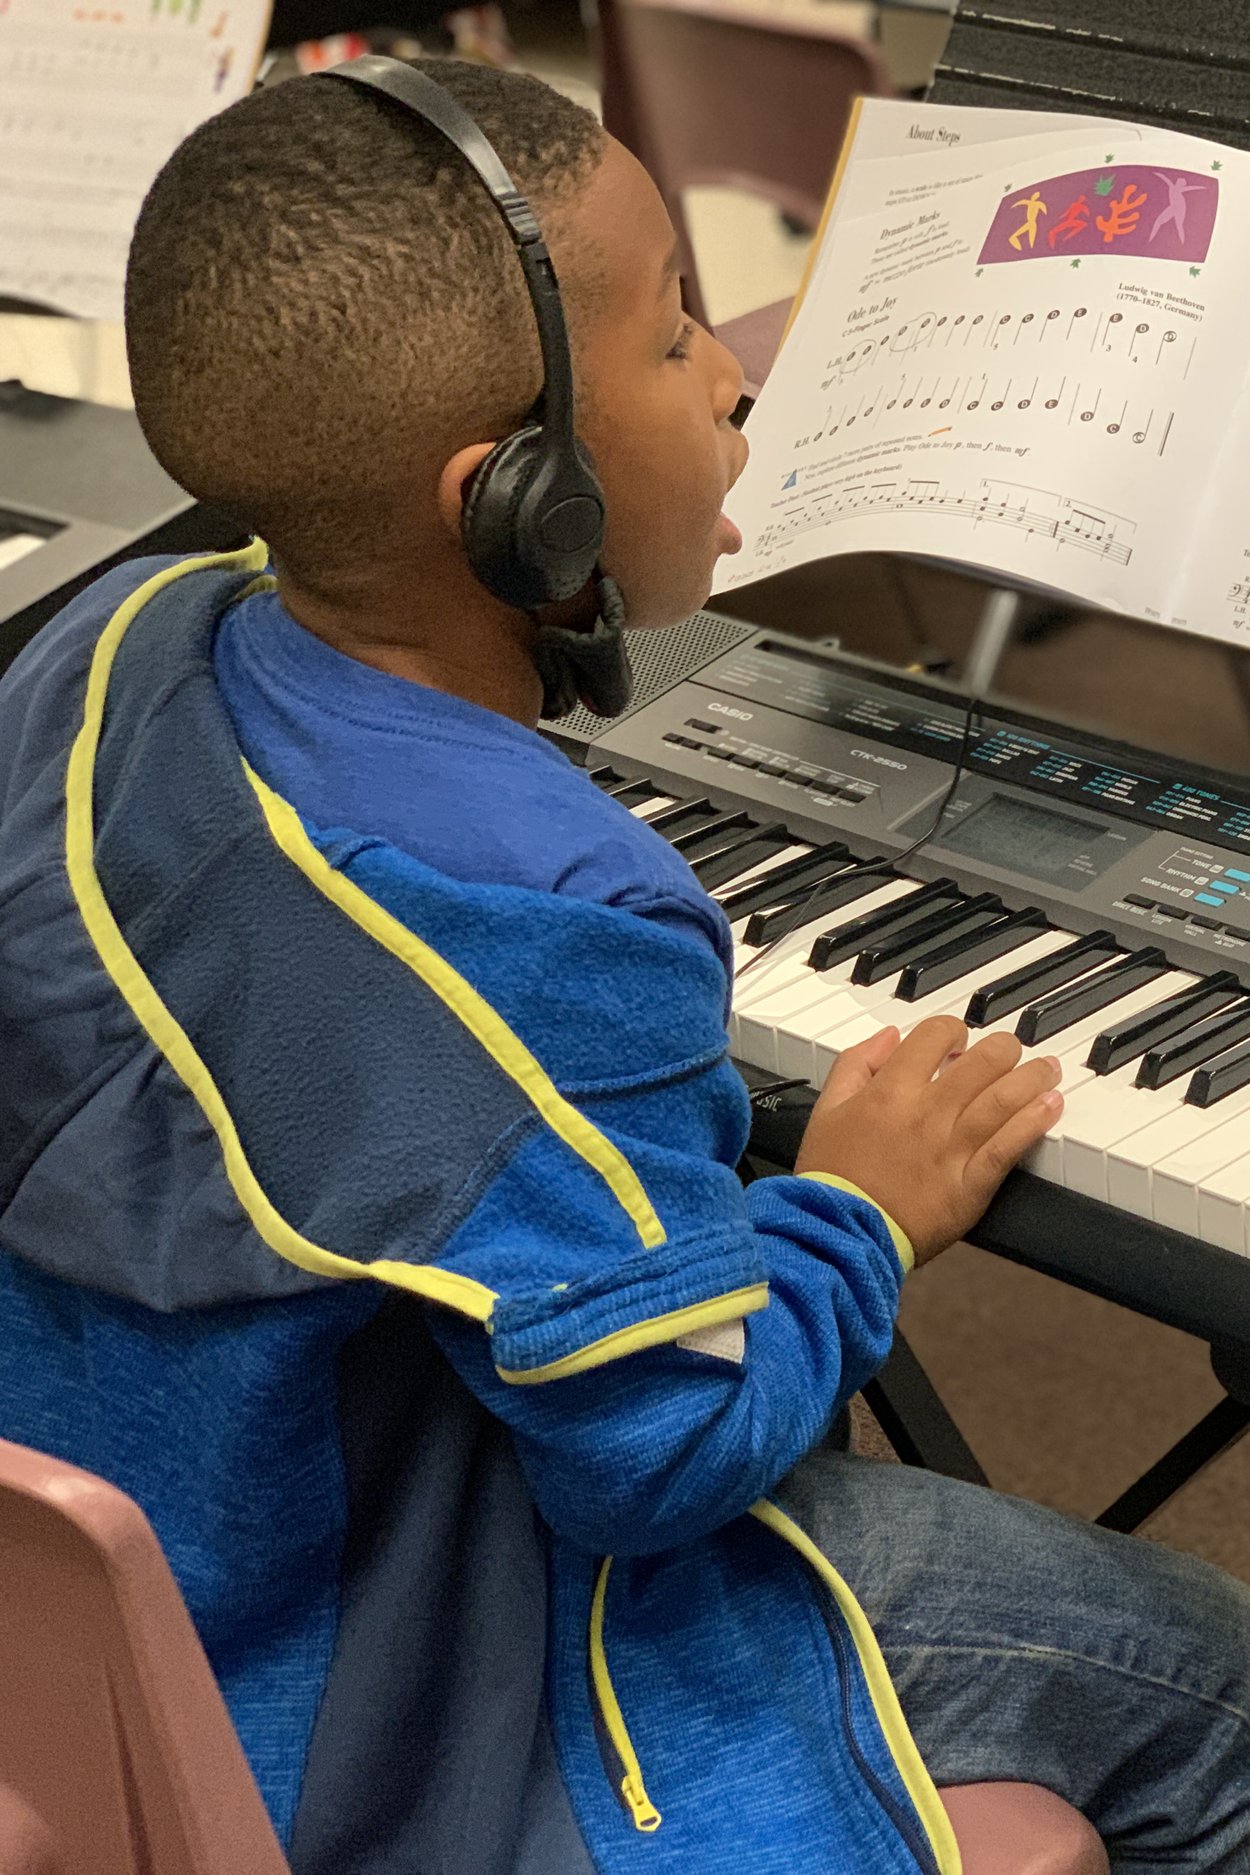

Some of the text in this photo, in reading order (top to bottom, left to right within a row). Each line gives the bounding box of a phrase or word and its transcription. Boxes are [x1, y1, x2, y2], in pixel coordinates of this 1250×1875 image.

[905, 124, 961, 146] About Steps
[1118, 282, 1205, 312] Ludwig van Beethoven
[847, 297, 898, 323] Ode to Joy
[1164, 303, 1203, 322] Germany)
[707, 702, 753, 721] CASIO
[850, 749, 907, 771] CTK-2550
[1192, 859, 1212, 870] TONE
[1165, 868, 1196, 881] RHYTHM
[1140, 876, 1182, 894] SONG BANK
